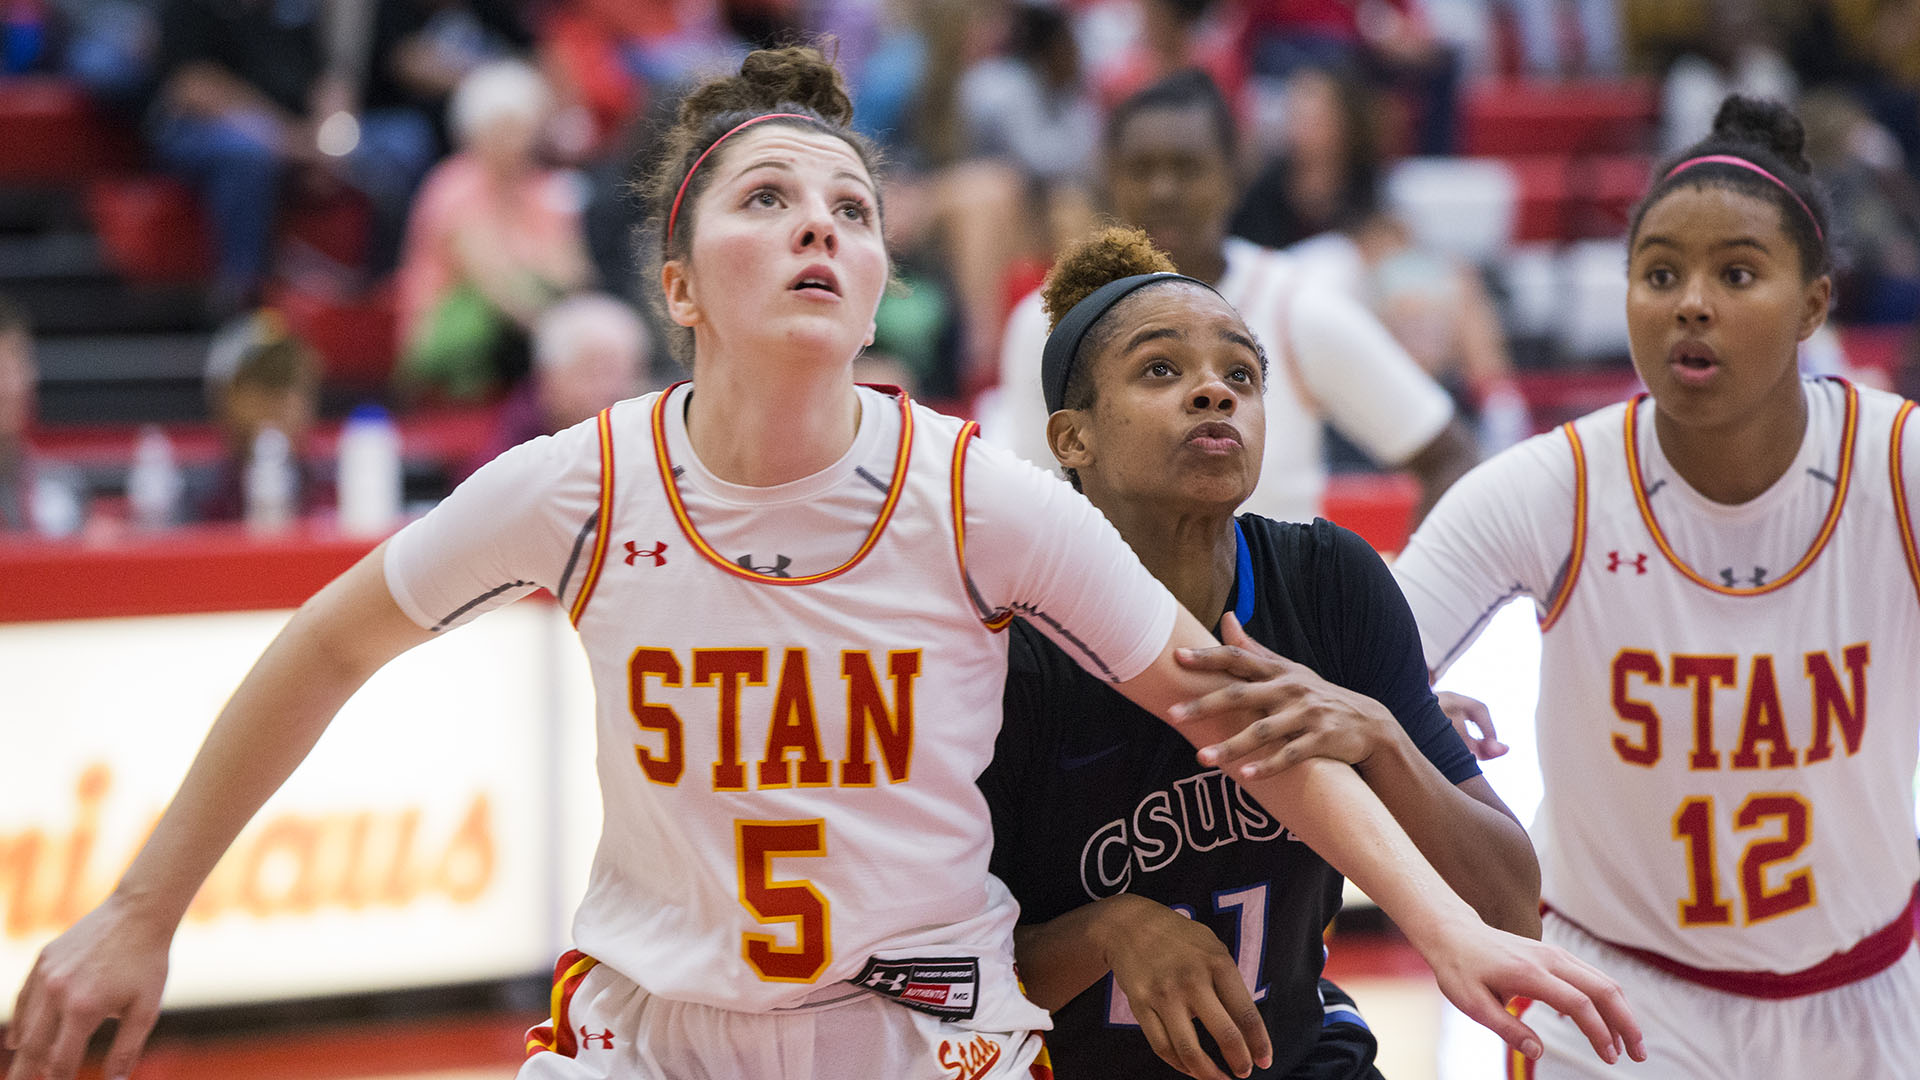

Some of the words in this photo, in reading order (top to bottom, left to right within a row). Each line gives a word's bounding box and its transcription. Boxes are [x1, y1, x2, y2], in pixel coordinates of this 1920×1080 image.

[628, 647, 923, 792] STAN
[1611, 641, 1870, 771] STAN
[734, 818, 832, 984] 5
[1080, 768, 1304, 901] CSUS
[1672, 791, 1817, 928] 12
[904, 987, 948, 1001] AUTHENTIC
[1104, 881, 1272, 1029] 1
